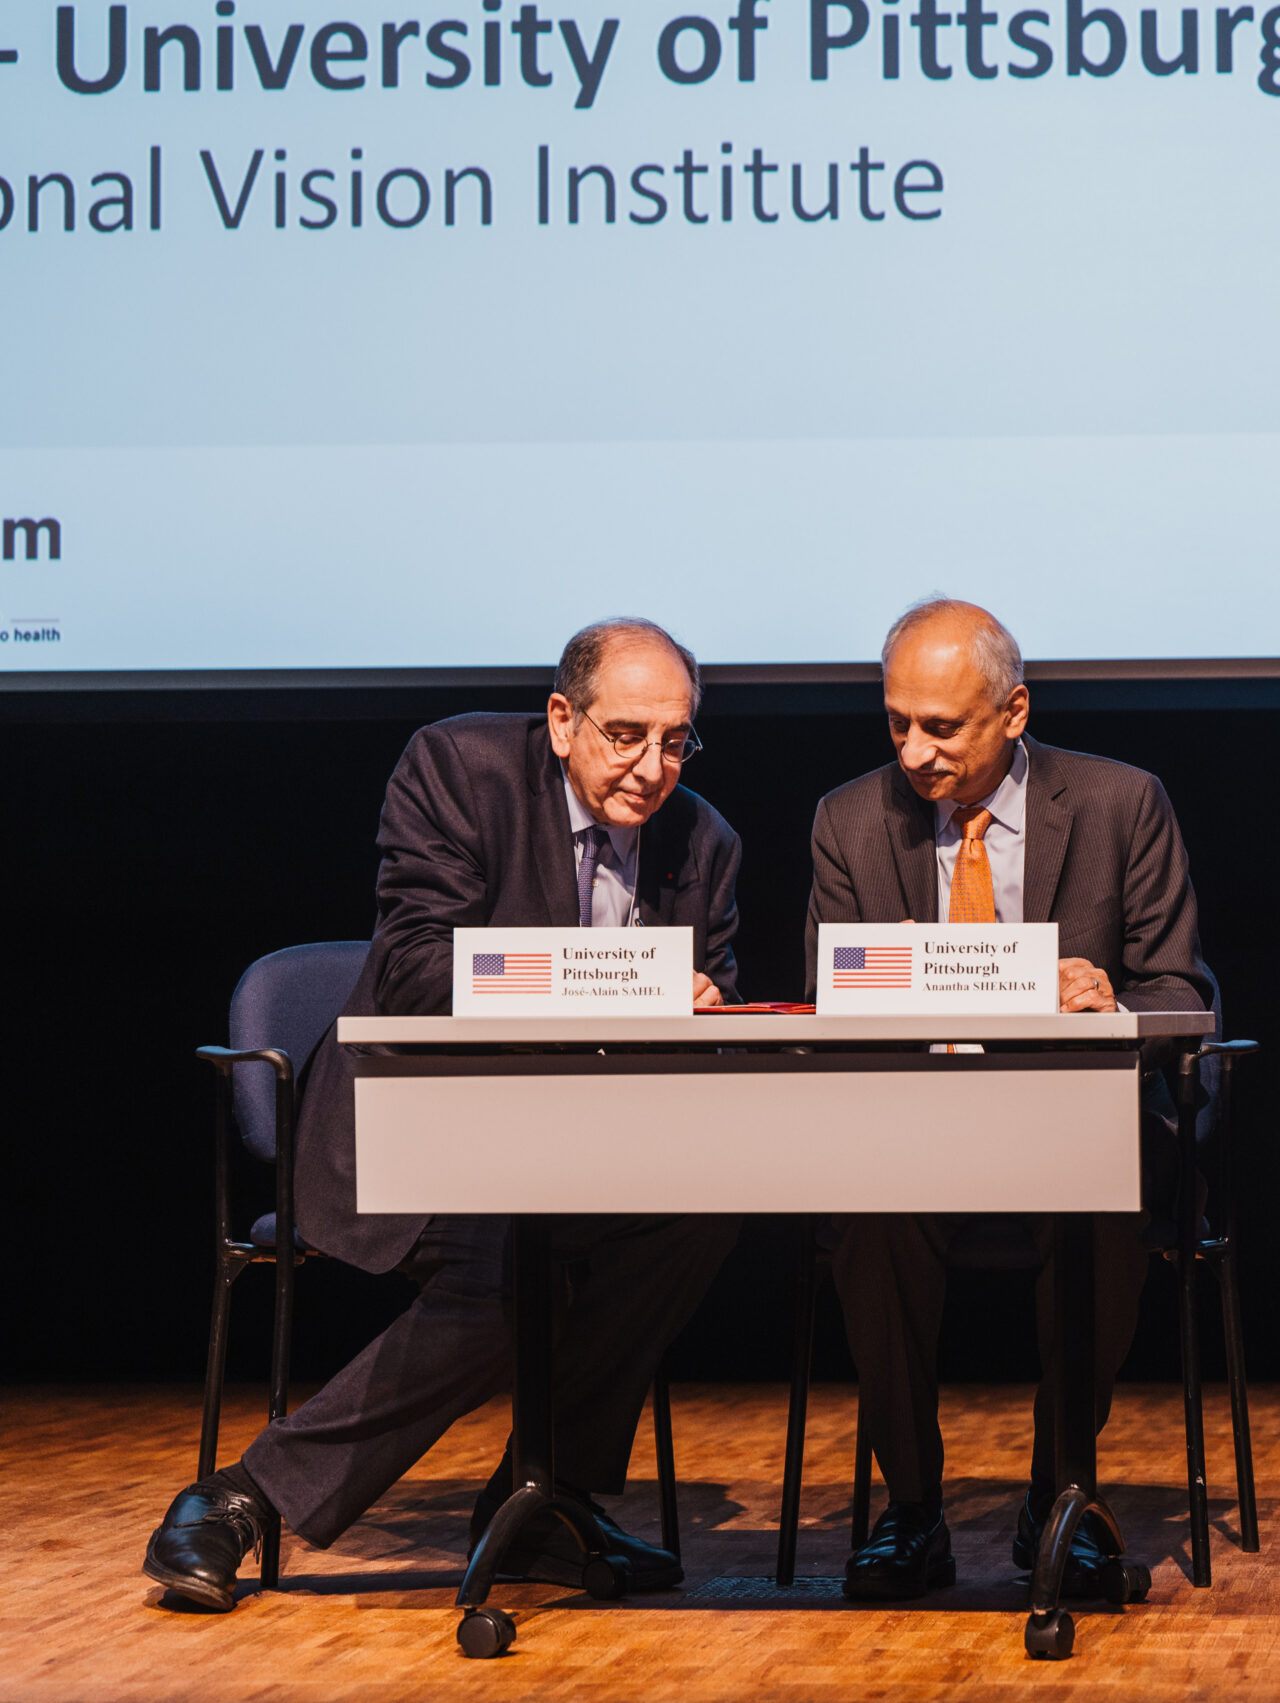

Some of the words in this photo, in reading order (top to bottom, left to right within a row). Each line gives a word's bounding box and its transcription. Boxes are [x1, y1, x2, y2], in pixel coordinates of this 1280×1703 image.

[56, 0, 620, 109] University
[657, 0, 770, 85] of
[0, 145, 162, 233] nal
[200, 147, 493, 230] Vision
[538, 142, 944, 225] Institute
[3, 517, 61, 560] m
[14, 628, 60, 642] health
[562, 947, 636, 963] University
[641, 947, 657, 960] of
[924, 941, 997, 957] University
[1002, 941, 1019, 954] of
[562, 967, 639, 982] Pittsburgh
[924, 962, 1000, 977] Pittsburgh
[561, 986, 619, 997] José-Alain
[621, 986, 665, 996] SAHEL
[922, 981, 970, 991] Anantha
[973, 981, 1037, 991] SHEKHAR
